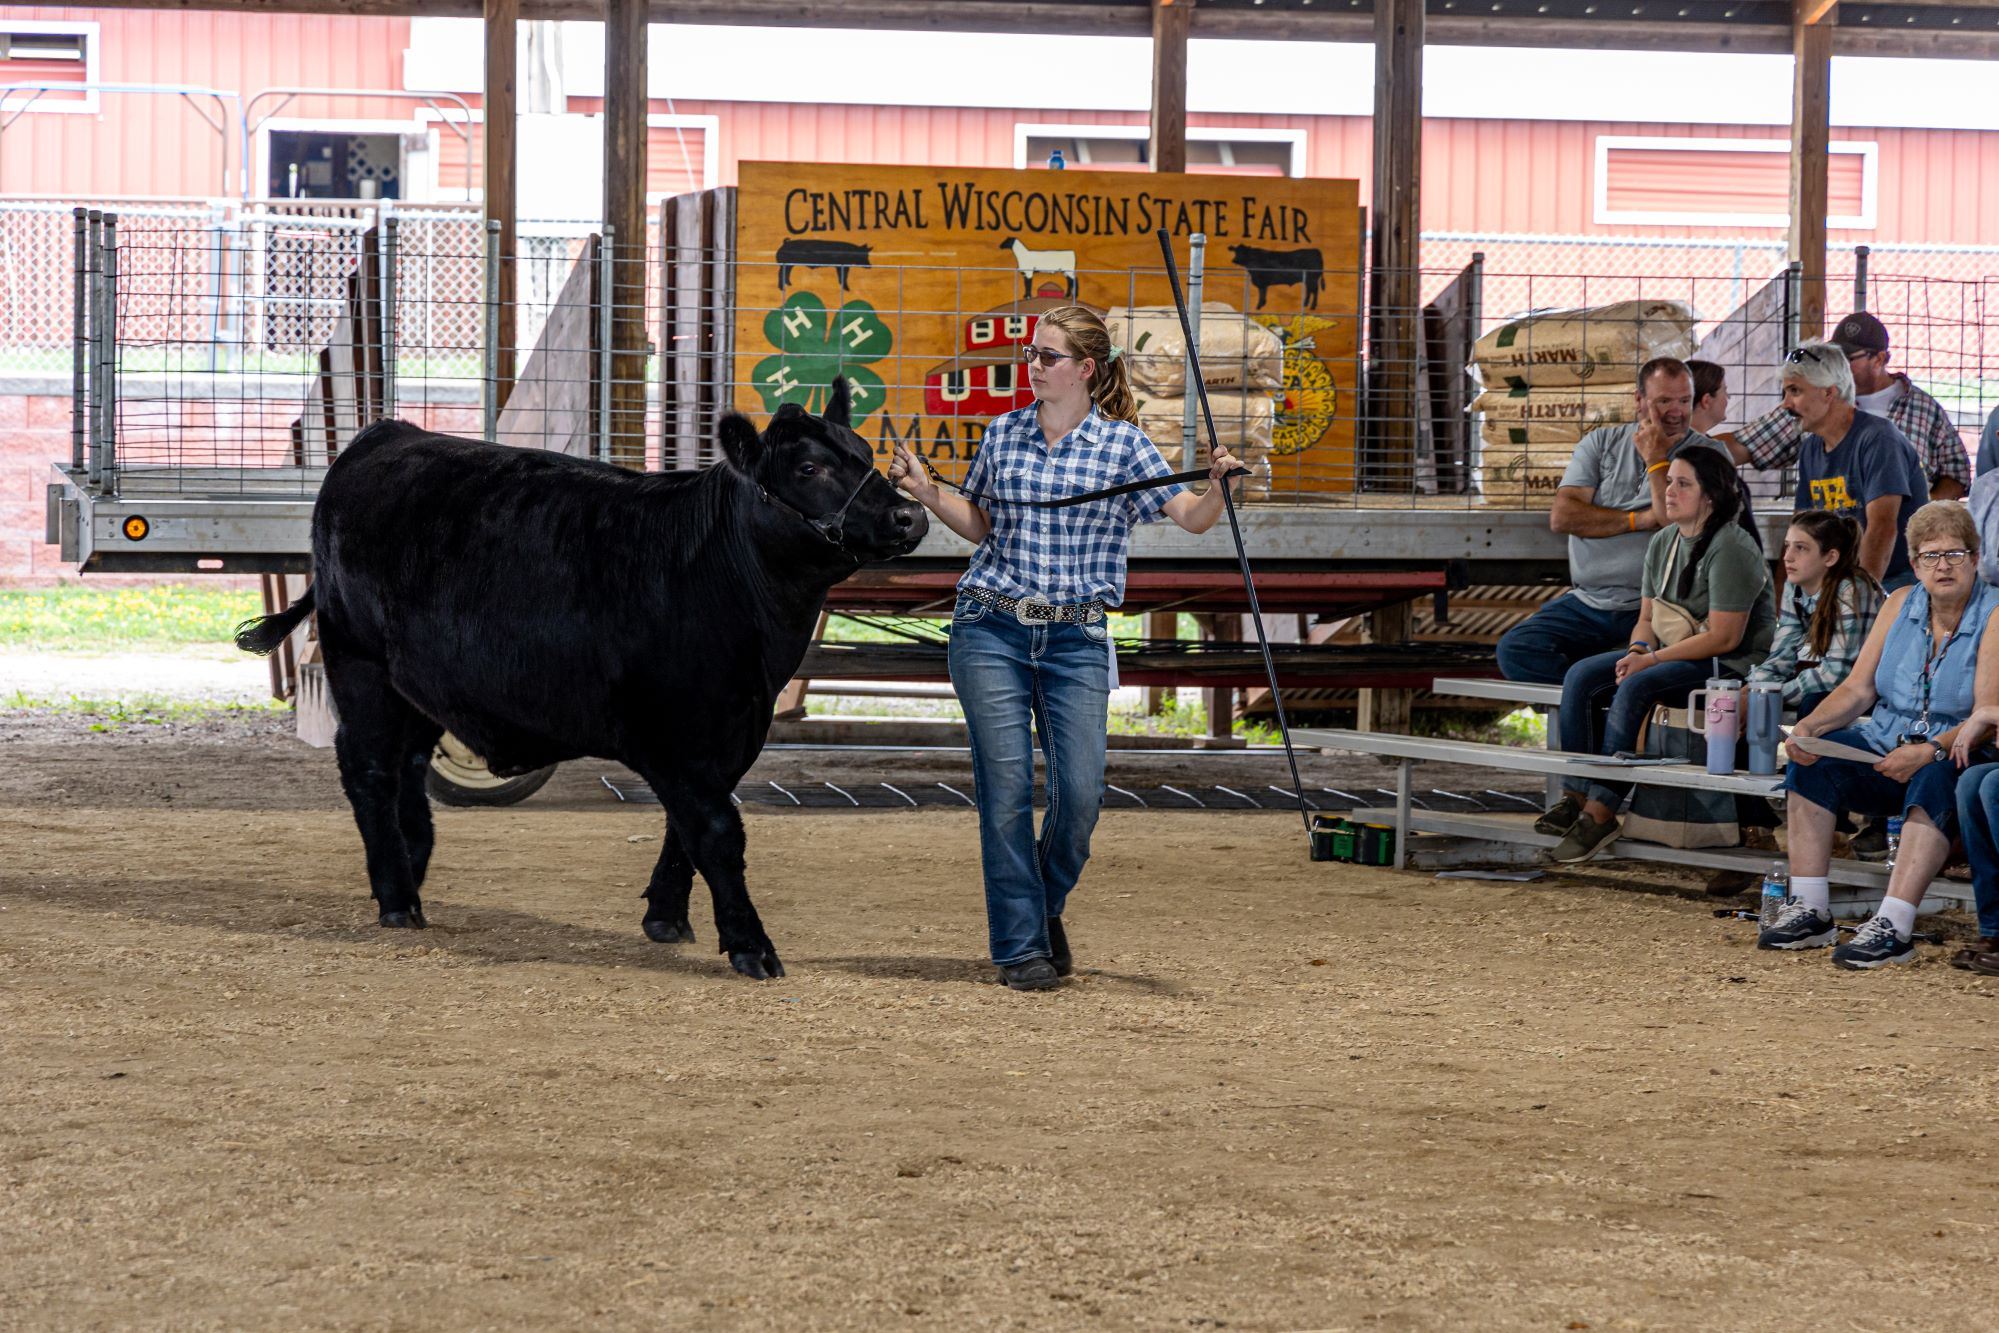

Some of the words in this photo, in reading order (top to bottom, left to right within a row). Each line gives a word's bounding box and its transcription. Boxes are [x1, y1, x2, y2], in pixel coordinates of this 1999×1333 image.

[785, 188, 929, 235] CENTRAL
[937, 182, 1131, 237] WISCONSIN
[1136, 192, 1229, 238] STATE
[1241, 196, 1312, 244] FAIR
[783, 305, 813, 338] H
[841, 316, 874, 348] H
[1510, 347, 1578, 368] MARTH
[766, 366, 799, 397] H
[1204, 376, 1235, 385] ARTH
[1519, 403, 1587, 419] MARTH
[1524, 475, 1563, 490] MAR
